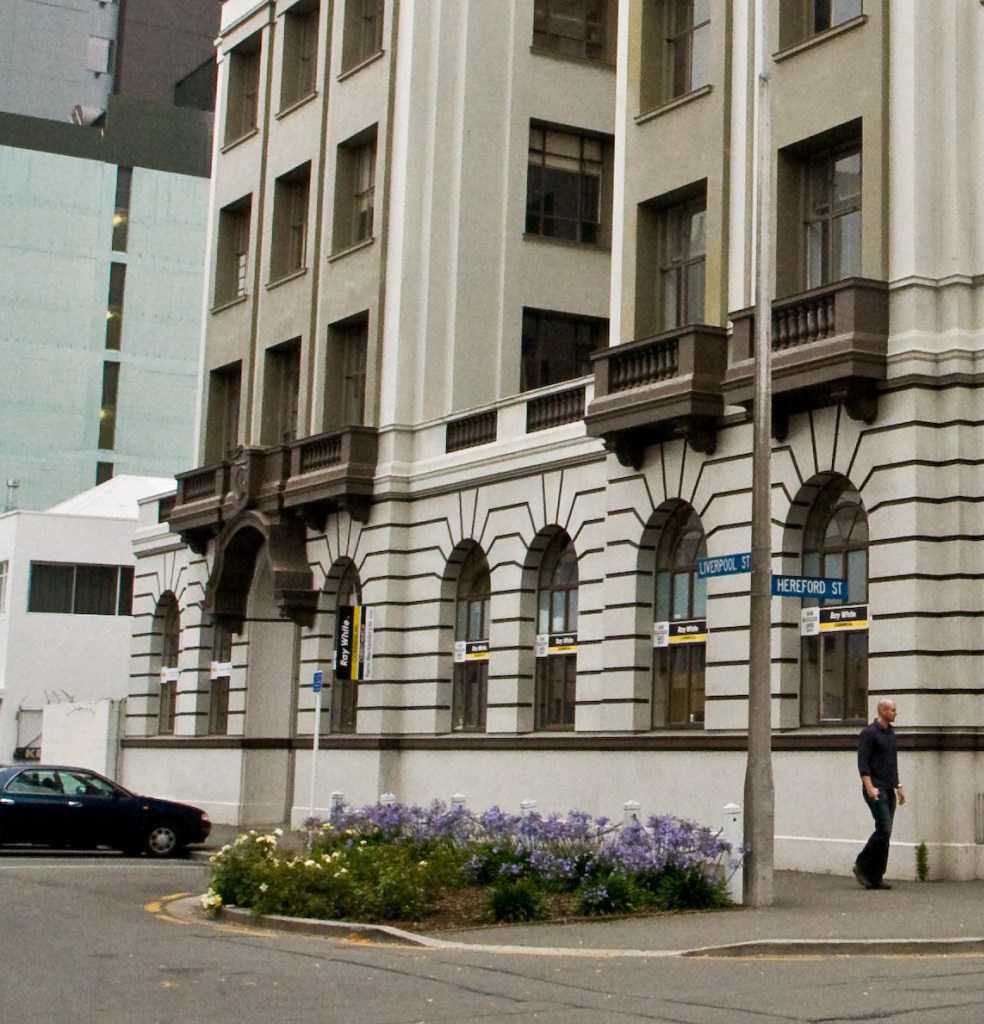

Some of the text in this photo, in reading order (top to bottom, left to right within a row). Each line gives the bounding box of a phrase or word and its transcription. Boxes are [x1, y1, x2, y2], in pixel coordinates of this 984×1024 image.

[700, 555, 750, 575] LIVERPOOL ST
[777, 578, 842, 595] HEREFORD ST
[340, 620, 350, 667] Ray White
